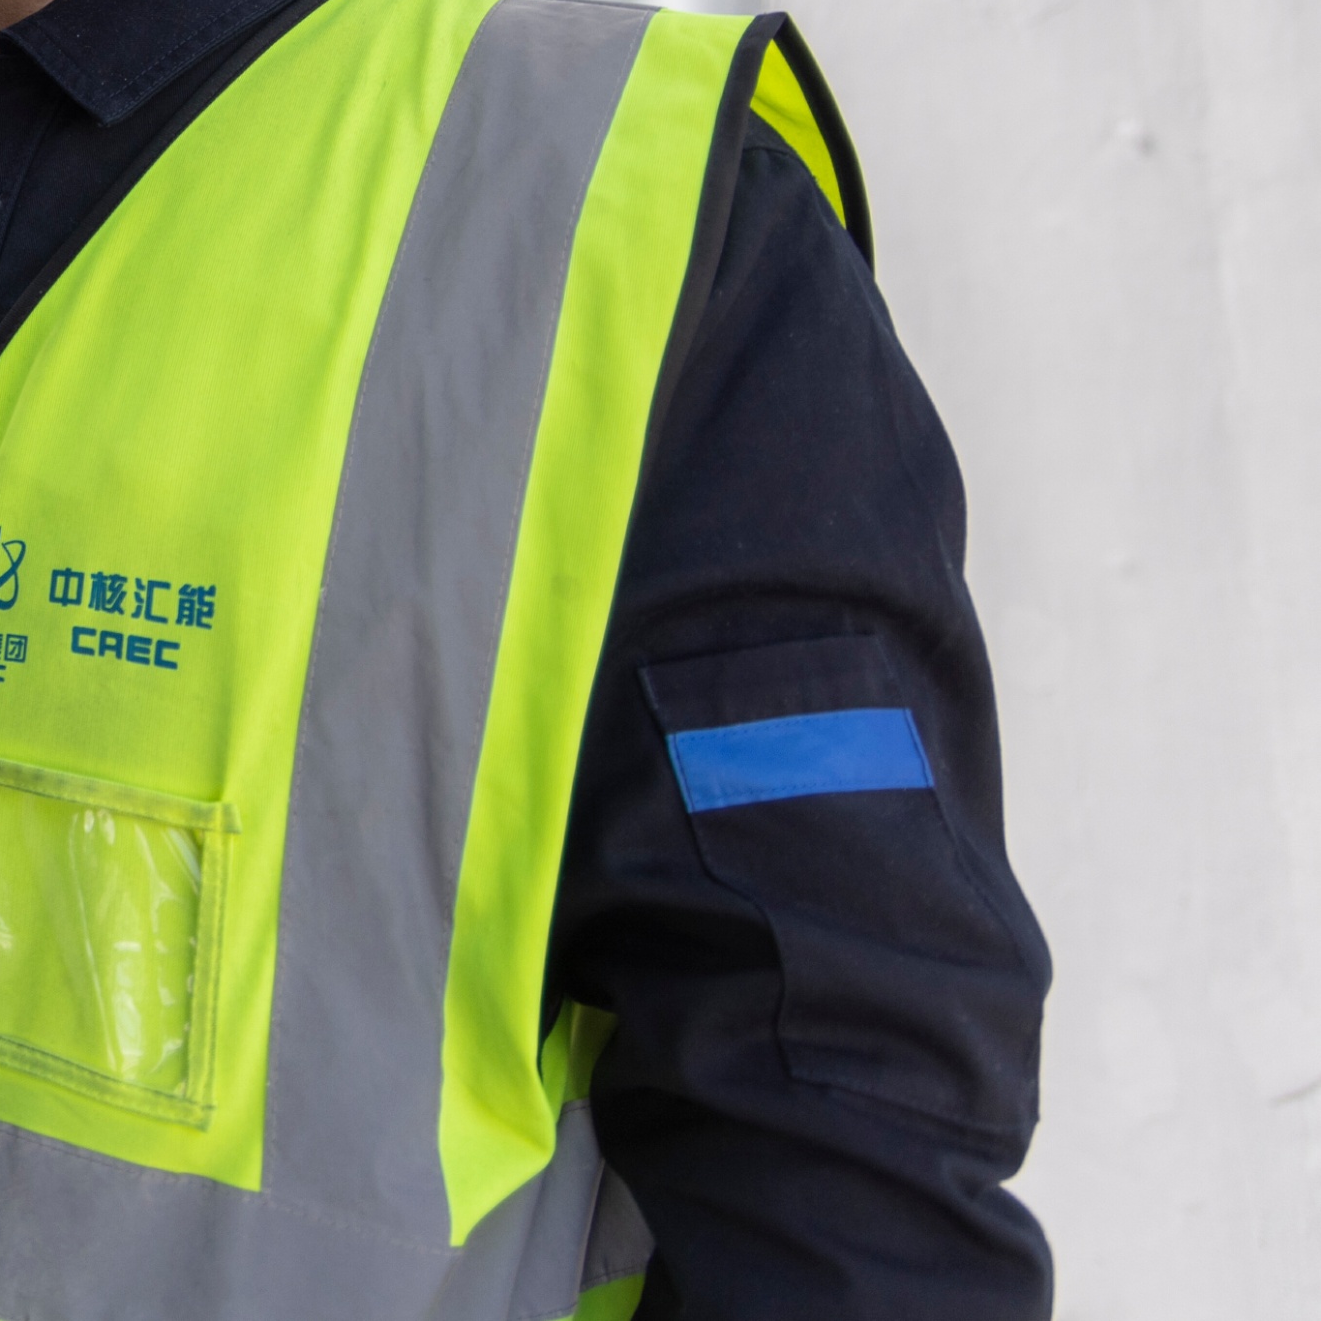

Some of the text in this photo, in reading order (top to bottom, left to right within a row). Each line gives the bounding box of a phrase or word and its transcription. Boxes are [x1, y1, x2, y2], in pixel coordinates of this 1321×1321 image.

[49, 567, 217, 629] 中核汇能
[71, 626, 181, 670] CAEC
